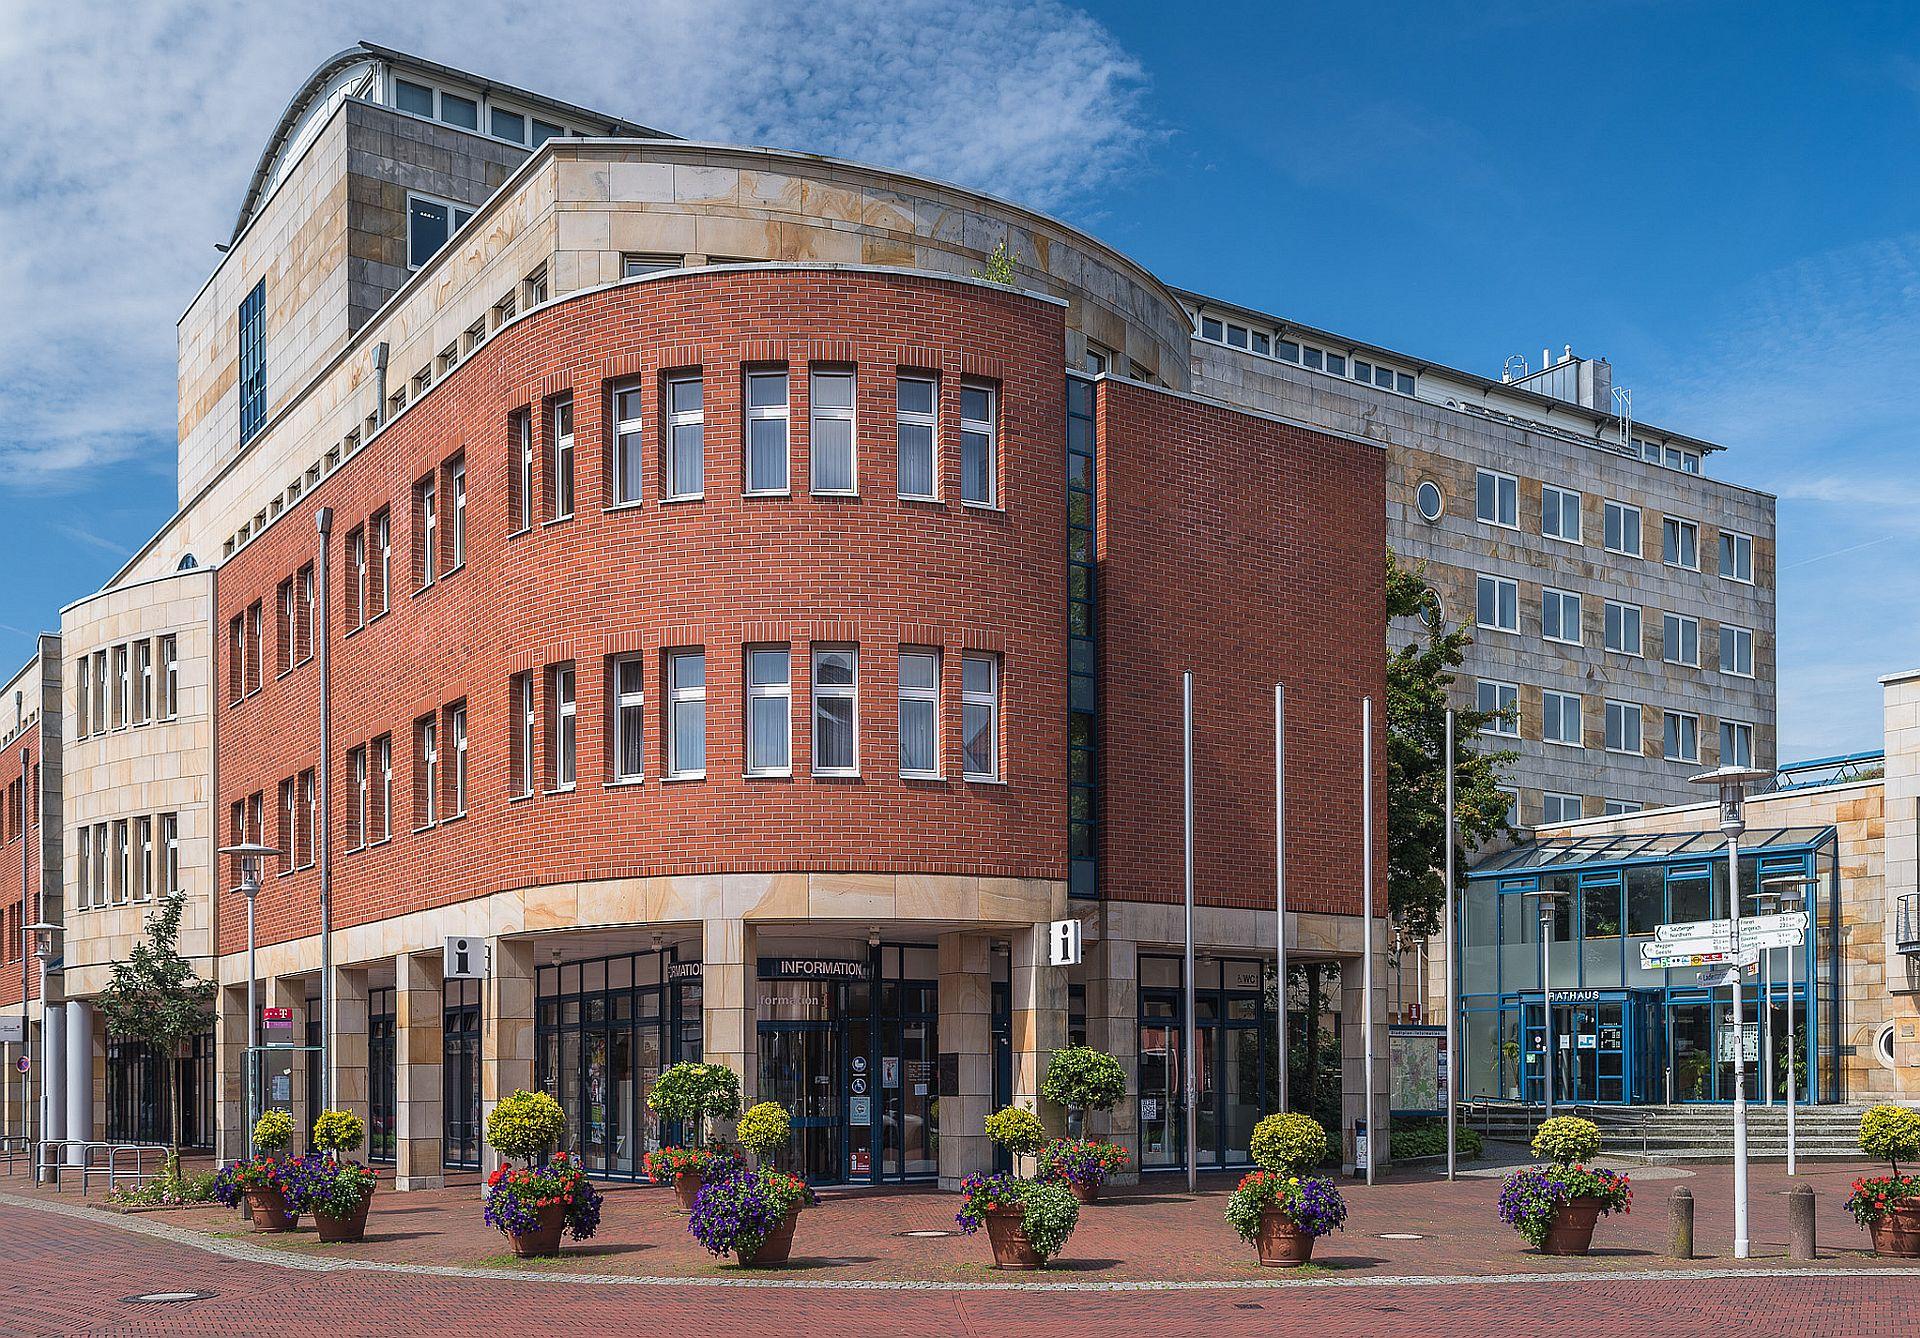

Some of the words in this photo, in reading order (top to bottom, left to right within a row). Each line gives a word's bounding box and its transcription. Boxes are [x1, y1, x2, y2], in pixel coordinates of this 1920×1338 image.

[781, 961, 862, 976] INFORMATION
[1243, 974, 1256, 984] WC
[1548, 991, 1599, 1002] RATHAUS
